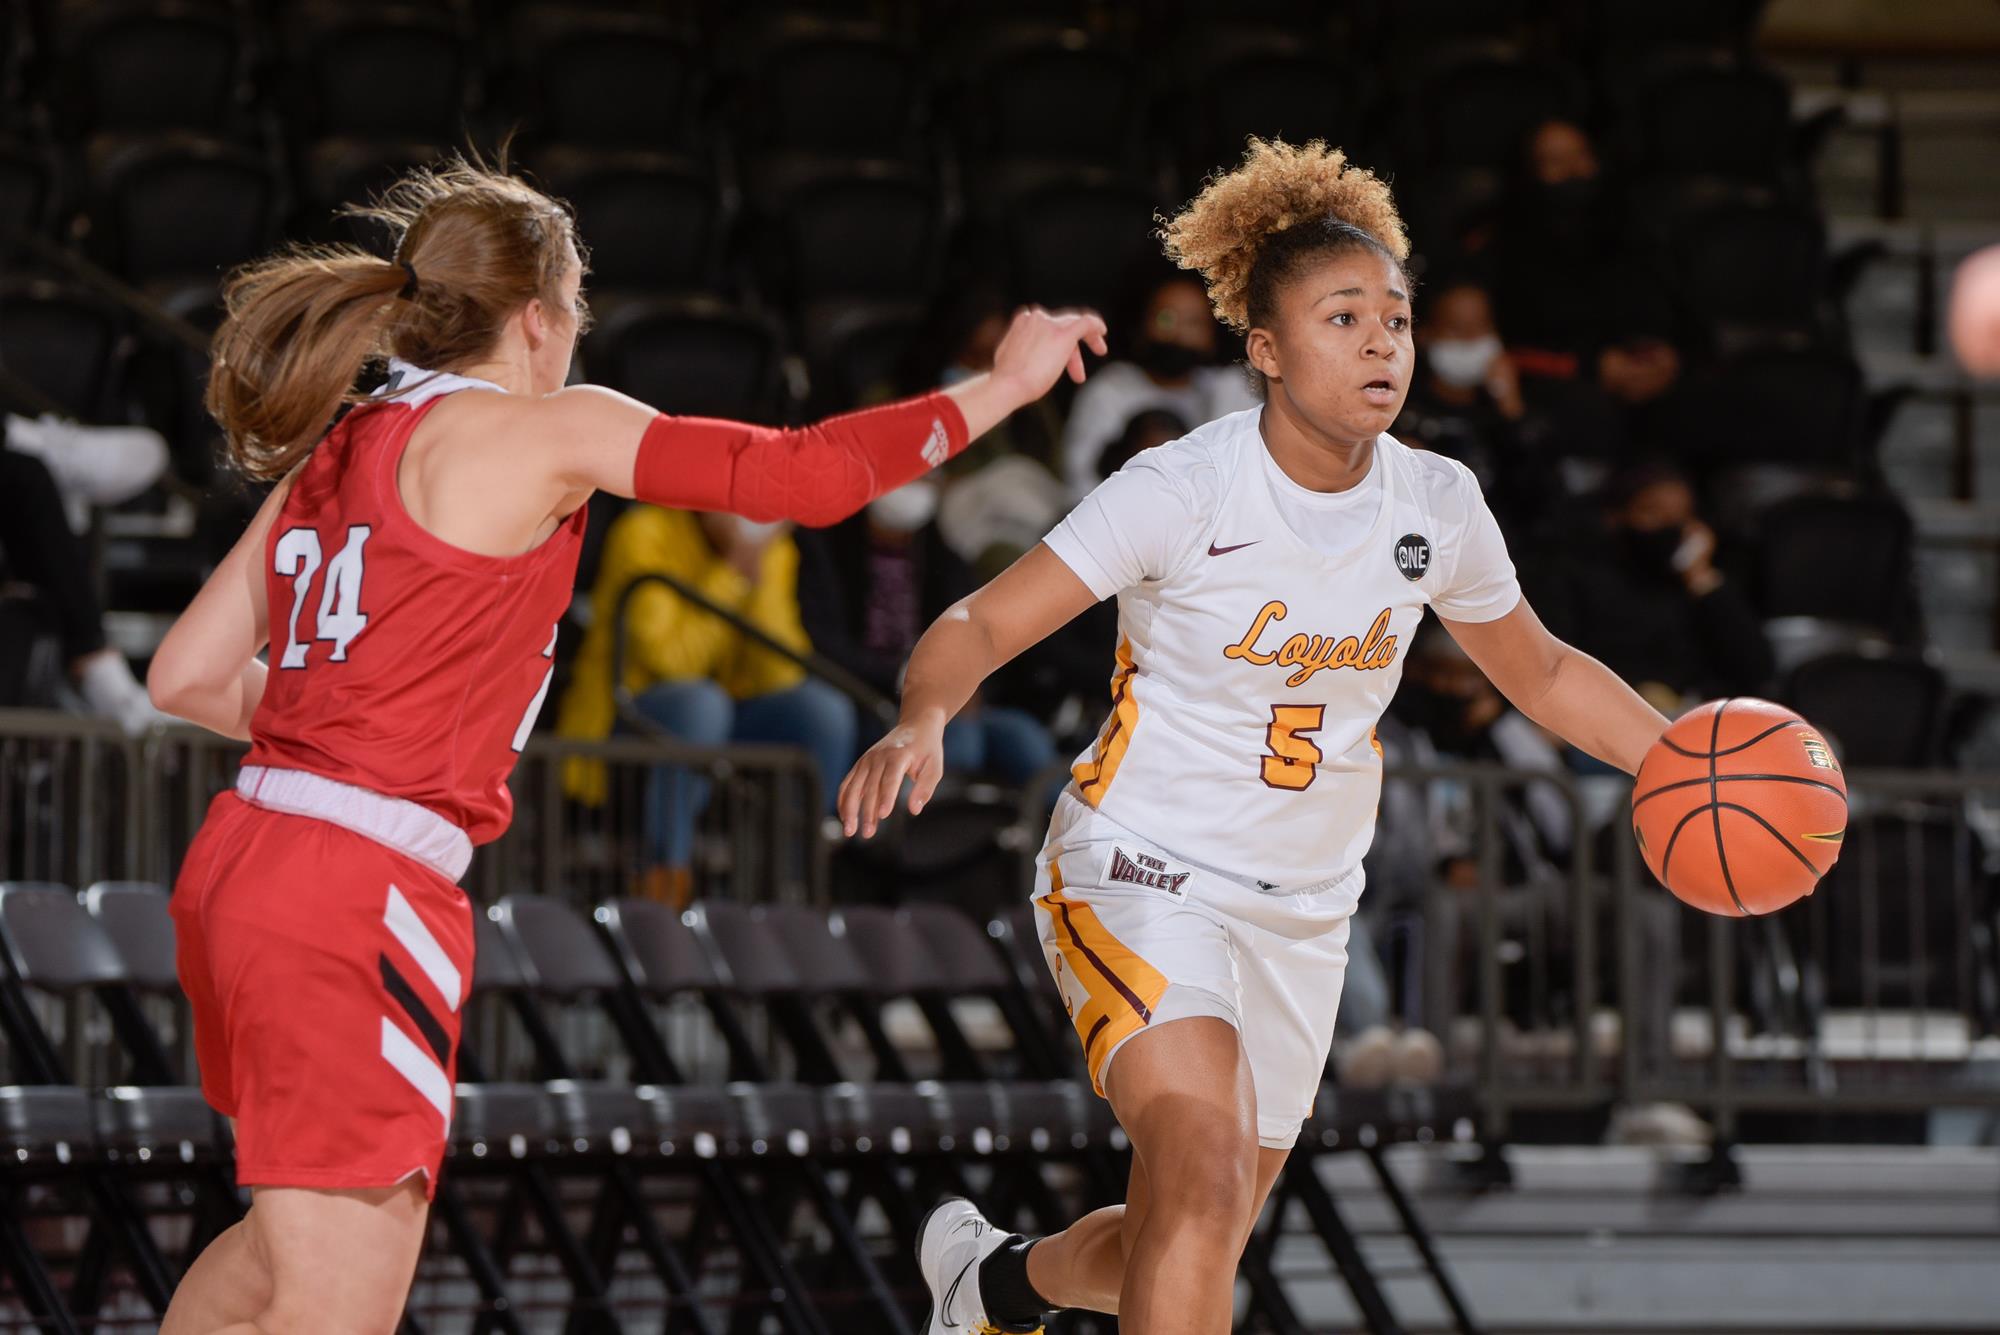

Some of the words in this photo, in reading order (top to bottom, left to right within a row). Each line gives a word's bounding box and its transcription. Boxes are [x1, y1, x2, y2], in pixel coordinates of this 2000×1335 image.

[1398, 545, 1428, 569] ONE
[274, 525, 372, 669] 24
[1223, 600, 1398, 687] Loyola
[1259, 703, 1327, 792] 5
[1109, 846, 1190, 895] VALLEY
[1137, 852, 1167, 872] THE
